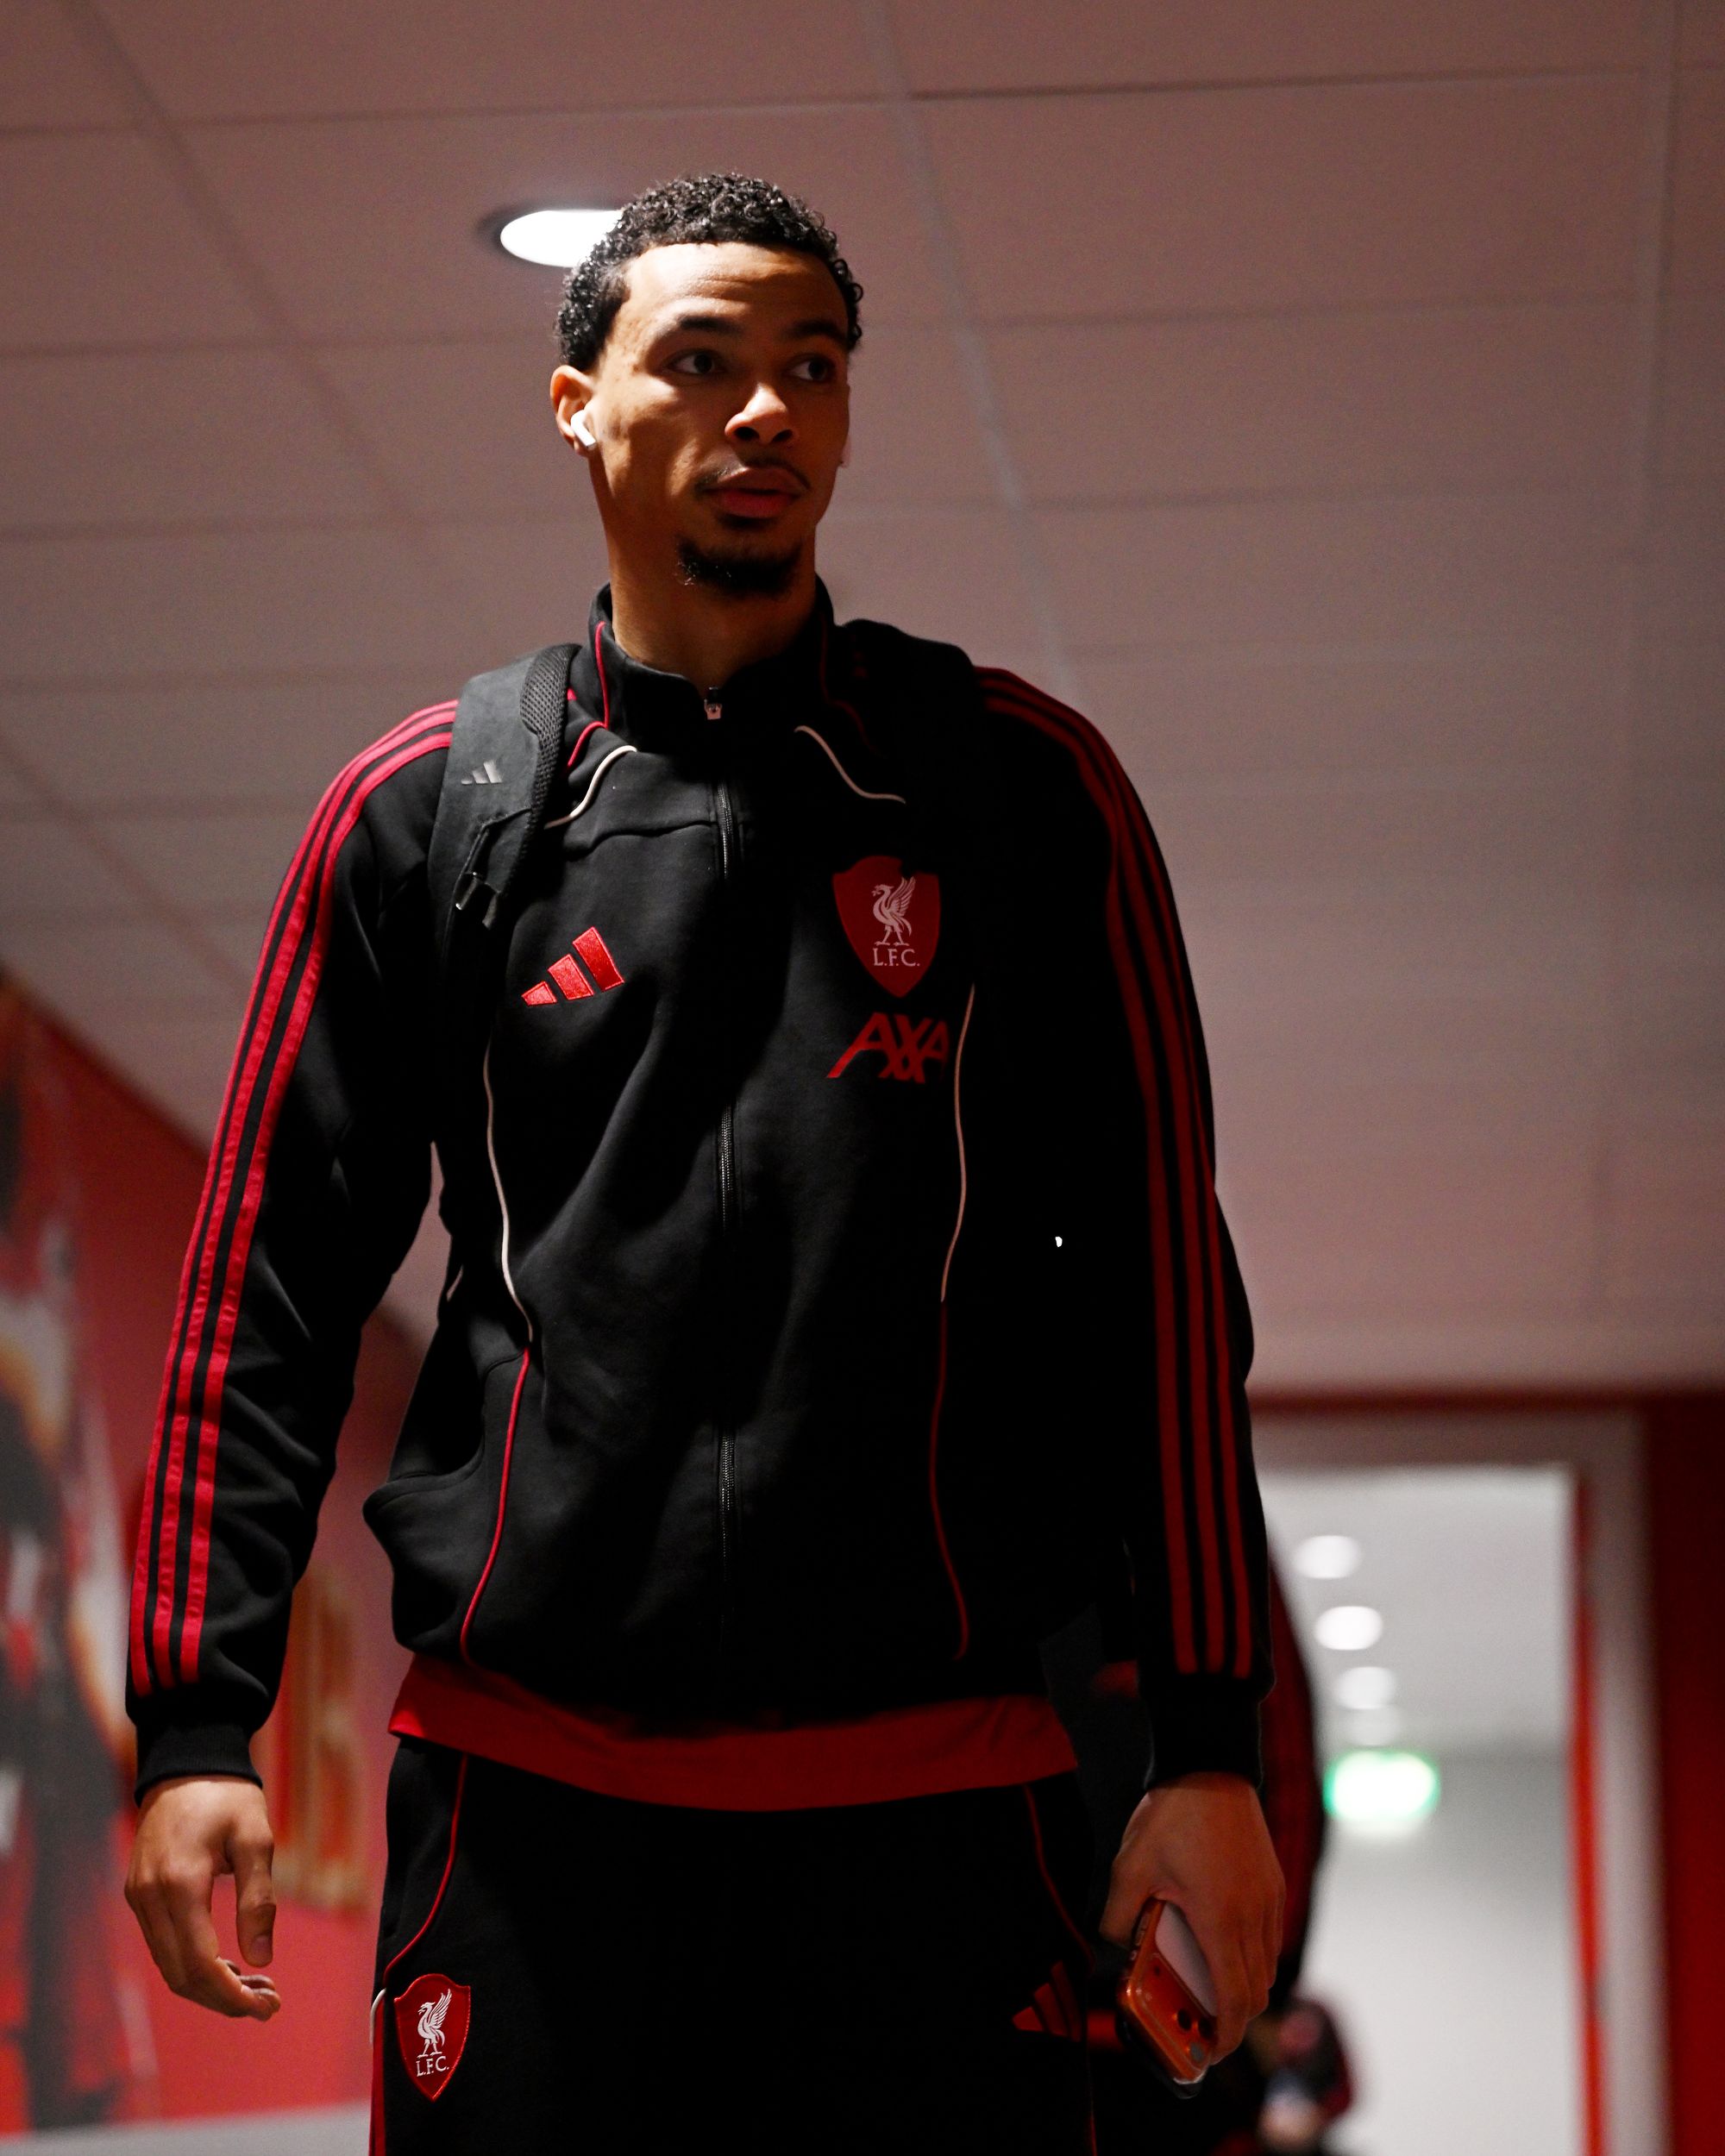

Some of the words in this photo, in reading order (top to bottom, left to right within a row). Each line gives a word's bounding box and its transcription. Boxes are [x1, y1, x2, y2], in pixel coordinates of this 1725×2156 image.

[873, 948, 920, 968] L.F.C.
[826, 1011, 952, 1085] AXA
[416, 2055, 450, 2078] L.F.C.
